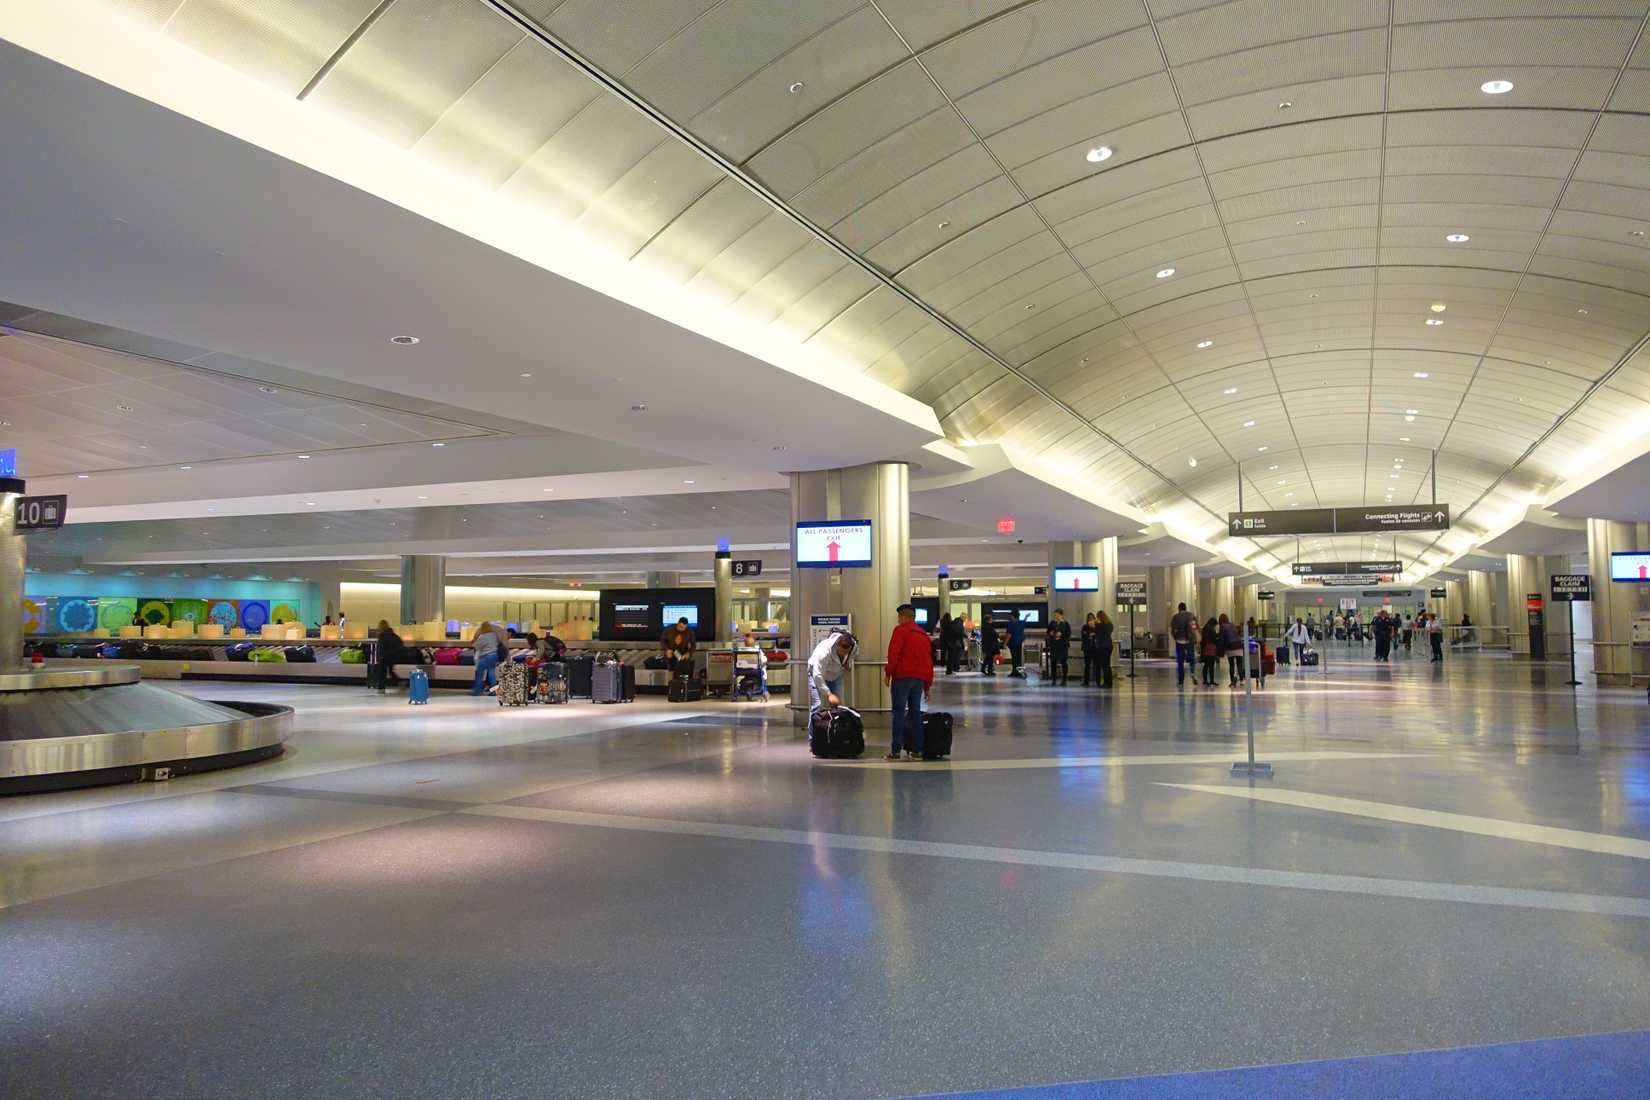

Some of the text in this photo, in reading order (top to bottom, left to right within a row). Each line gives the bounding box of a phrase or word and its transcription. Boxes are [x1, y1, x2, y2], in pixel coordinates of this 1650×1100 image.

[17, 502, 40, 524] 10
[735, 563, 743, 574] 8
[952, 580, 959, 589] 6
